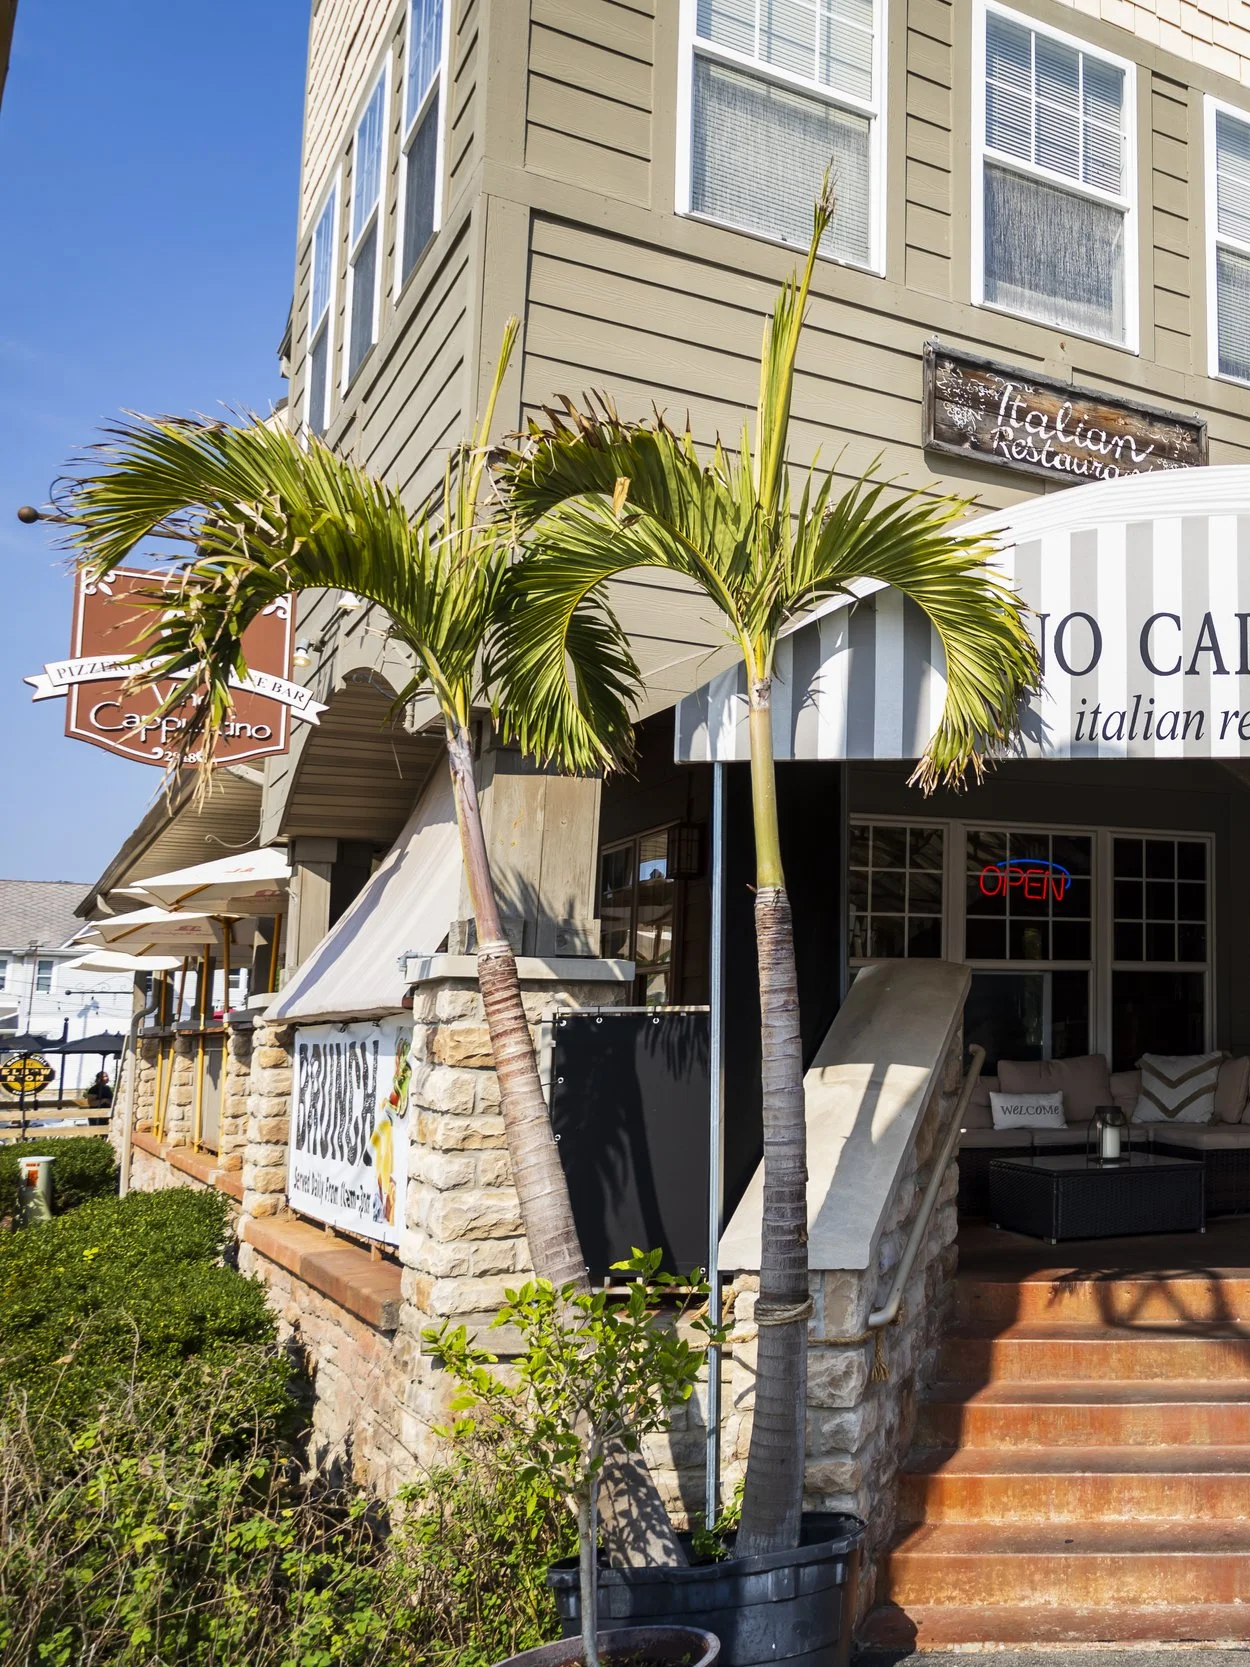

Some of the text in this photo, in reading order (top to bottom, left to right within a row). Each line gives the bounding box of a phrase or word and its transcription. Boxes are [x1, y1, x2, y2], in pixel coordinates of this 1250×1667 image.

[997, 382, 1155, 463] Italian
[271, 681, 305, 703] BAR
[1074, 695, 1205, 742] italian
[979, 865, 1065, 901] OPEN
[296, 1040, 379, 1167] BRUNCH
